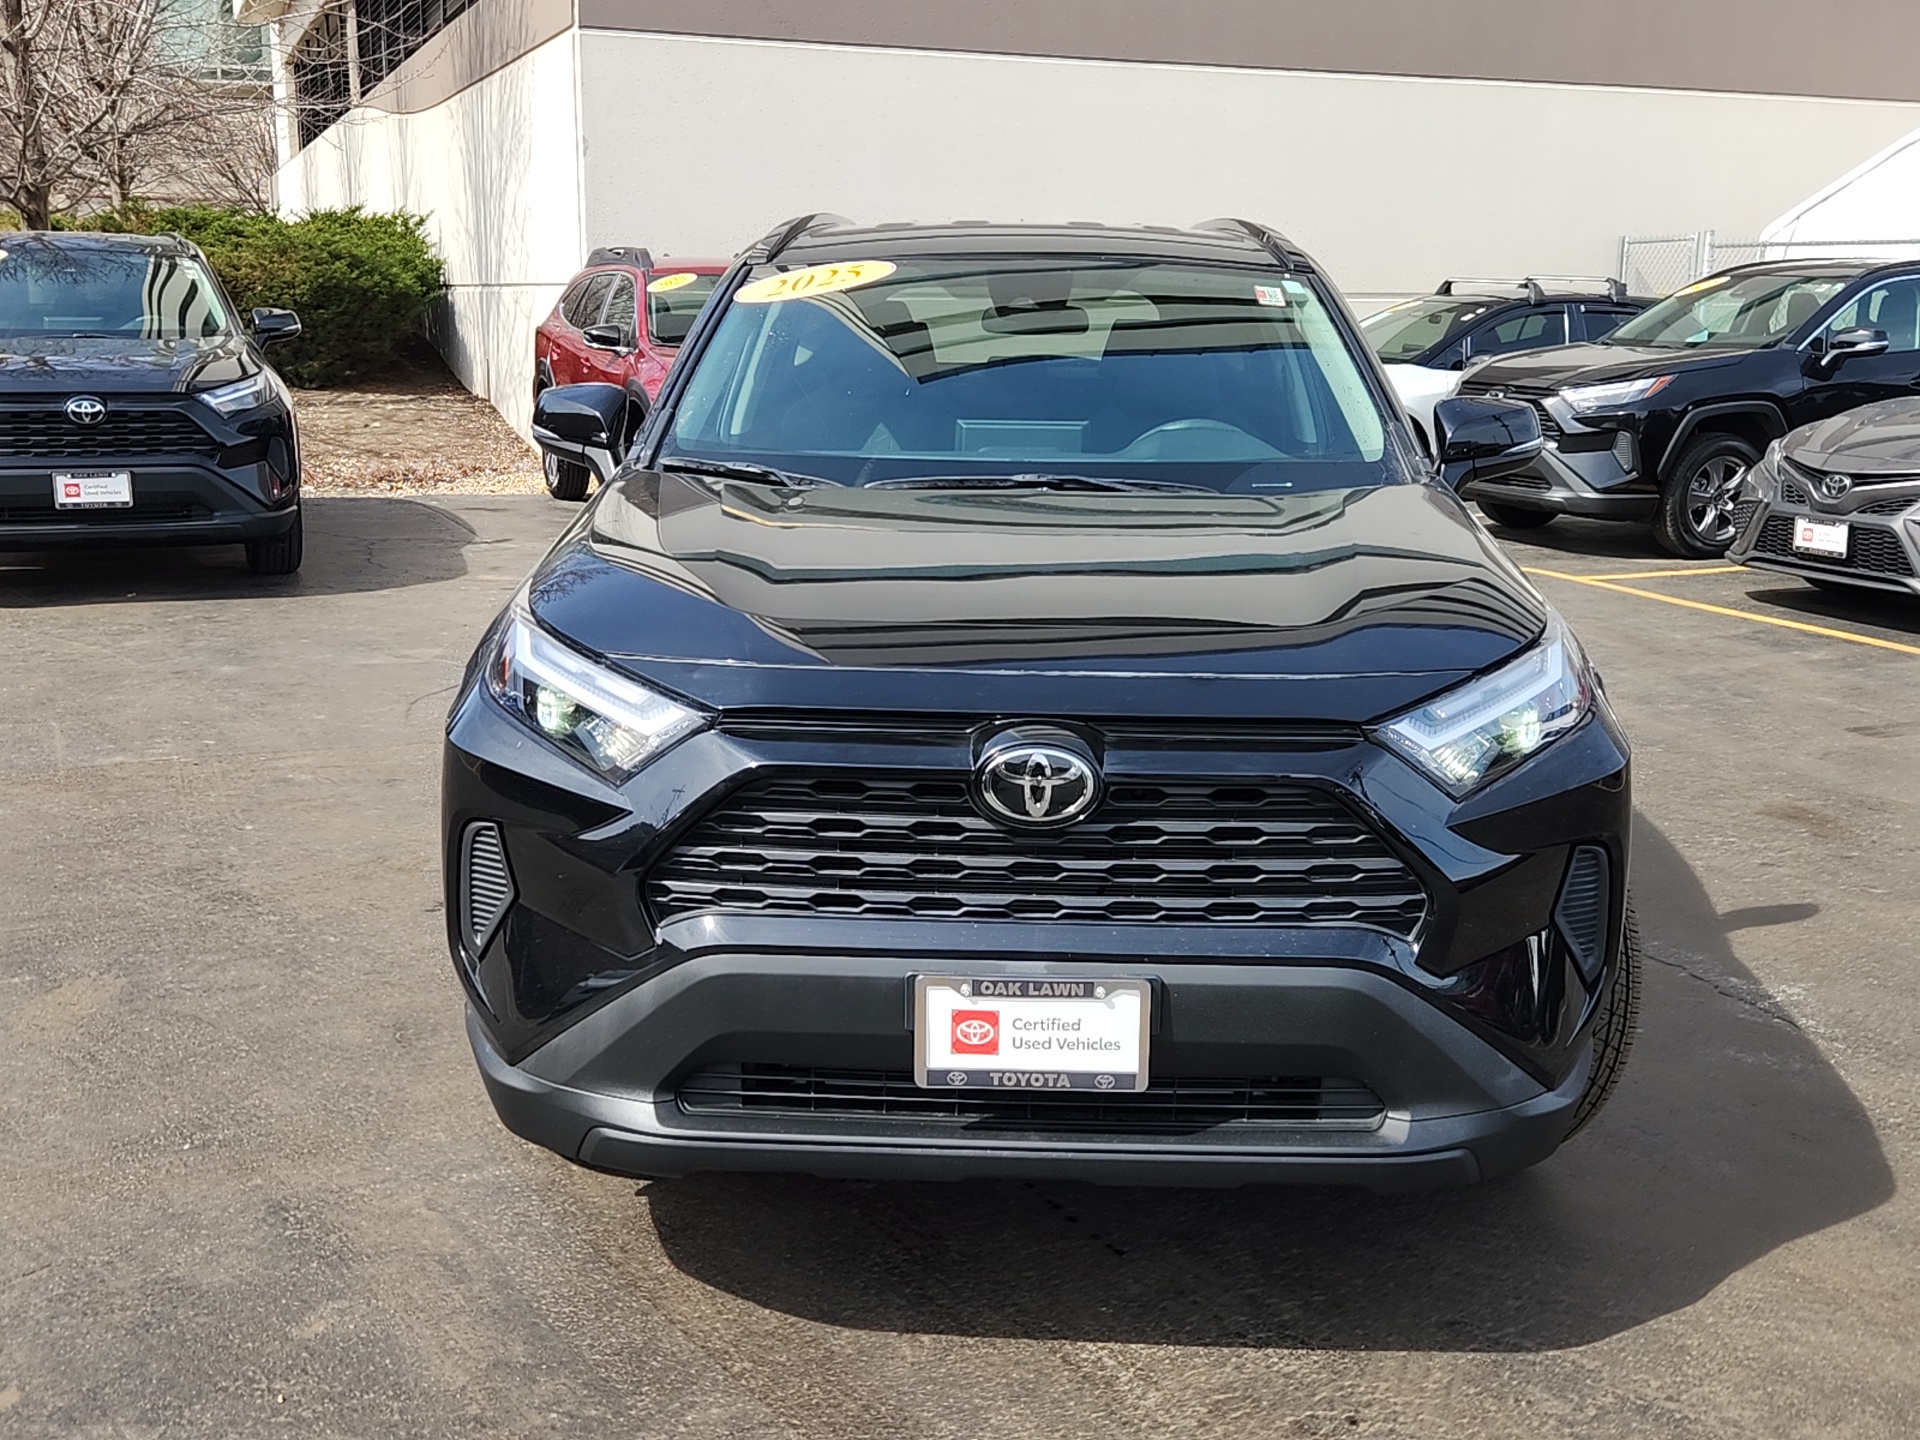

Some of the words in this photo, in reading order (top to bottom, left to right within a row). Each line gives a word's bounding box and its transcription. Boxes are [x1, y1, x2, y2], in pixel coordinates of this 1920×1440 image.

[764, 265, 865, 298] 2025
[980, 981, 1022, 996] OAK
[1027, 981, 1085, 997] LAWN
[1012, 1017, 1081, 1032] Certified
[1012, 1036, 1051, 1050] Used
[1056, 1036, 1121, 1051] Vehicles
[989, 1072, 1071, 1088] TOYOTA
